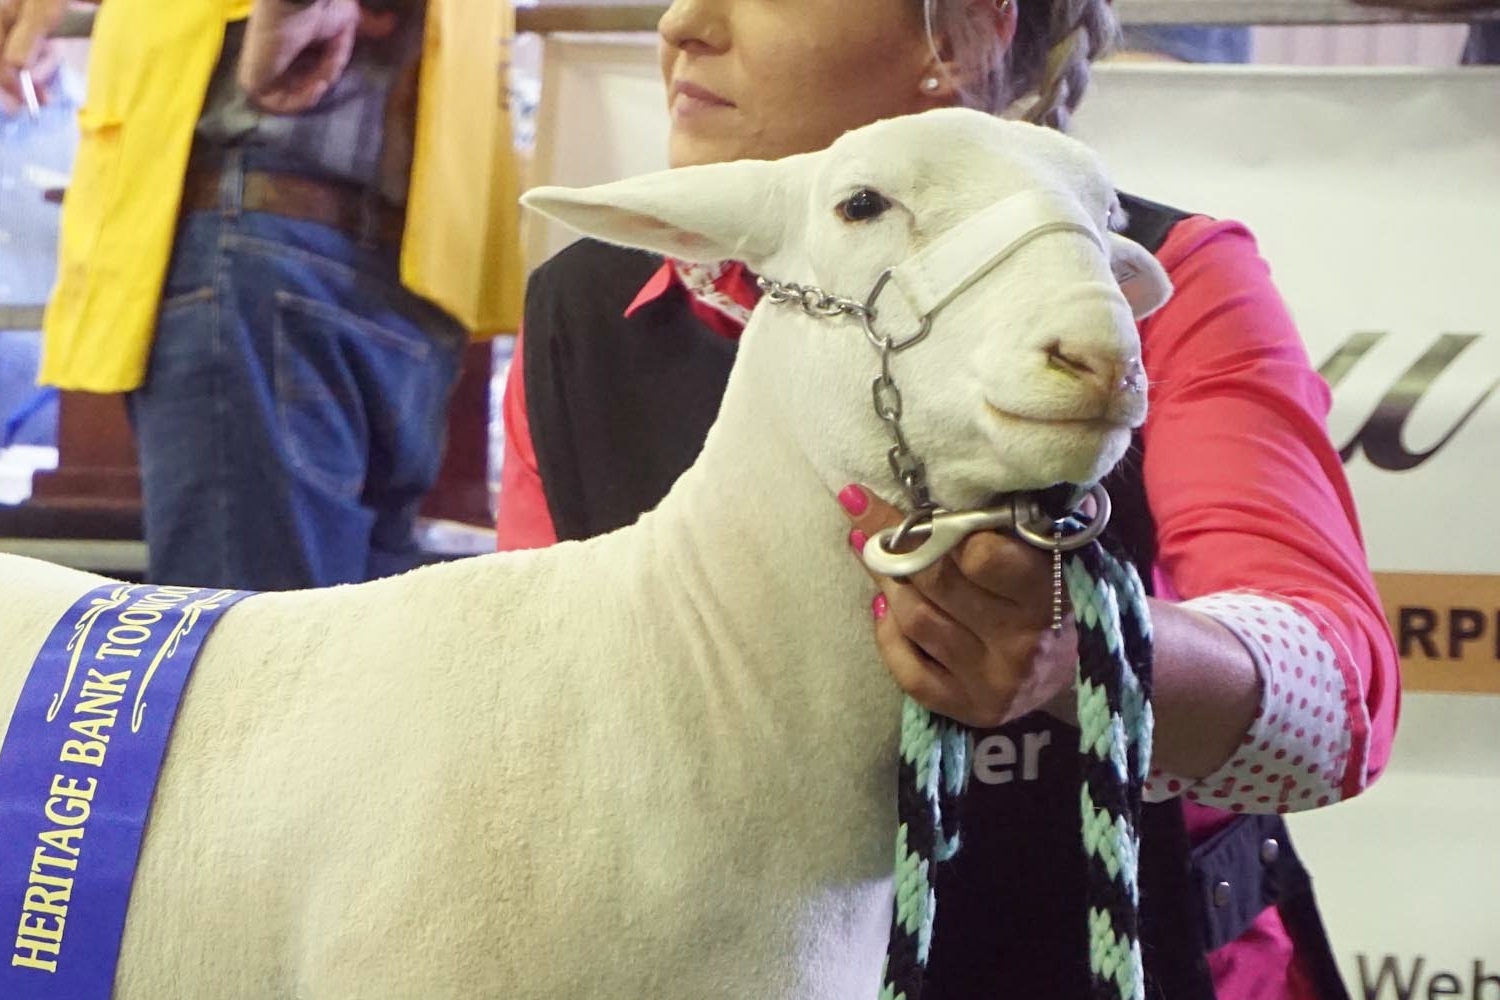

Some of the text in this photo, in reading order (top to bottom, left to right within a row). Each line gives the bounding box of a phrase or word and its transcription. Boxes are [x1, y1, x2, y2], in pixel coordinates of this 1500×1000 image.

[1399, 606, 1500, 661] RP
[973, 729, 1051, 785] er
[10, 773, 99, 974] HERITAGE
[58, 667, 133, 768] BANK
